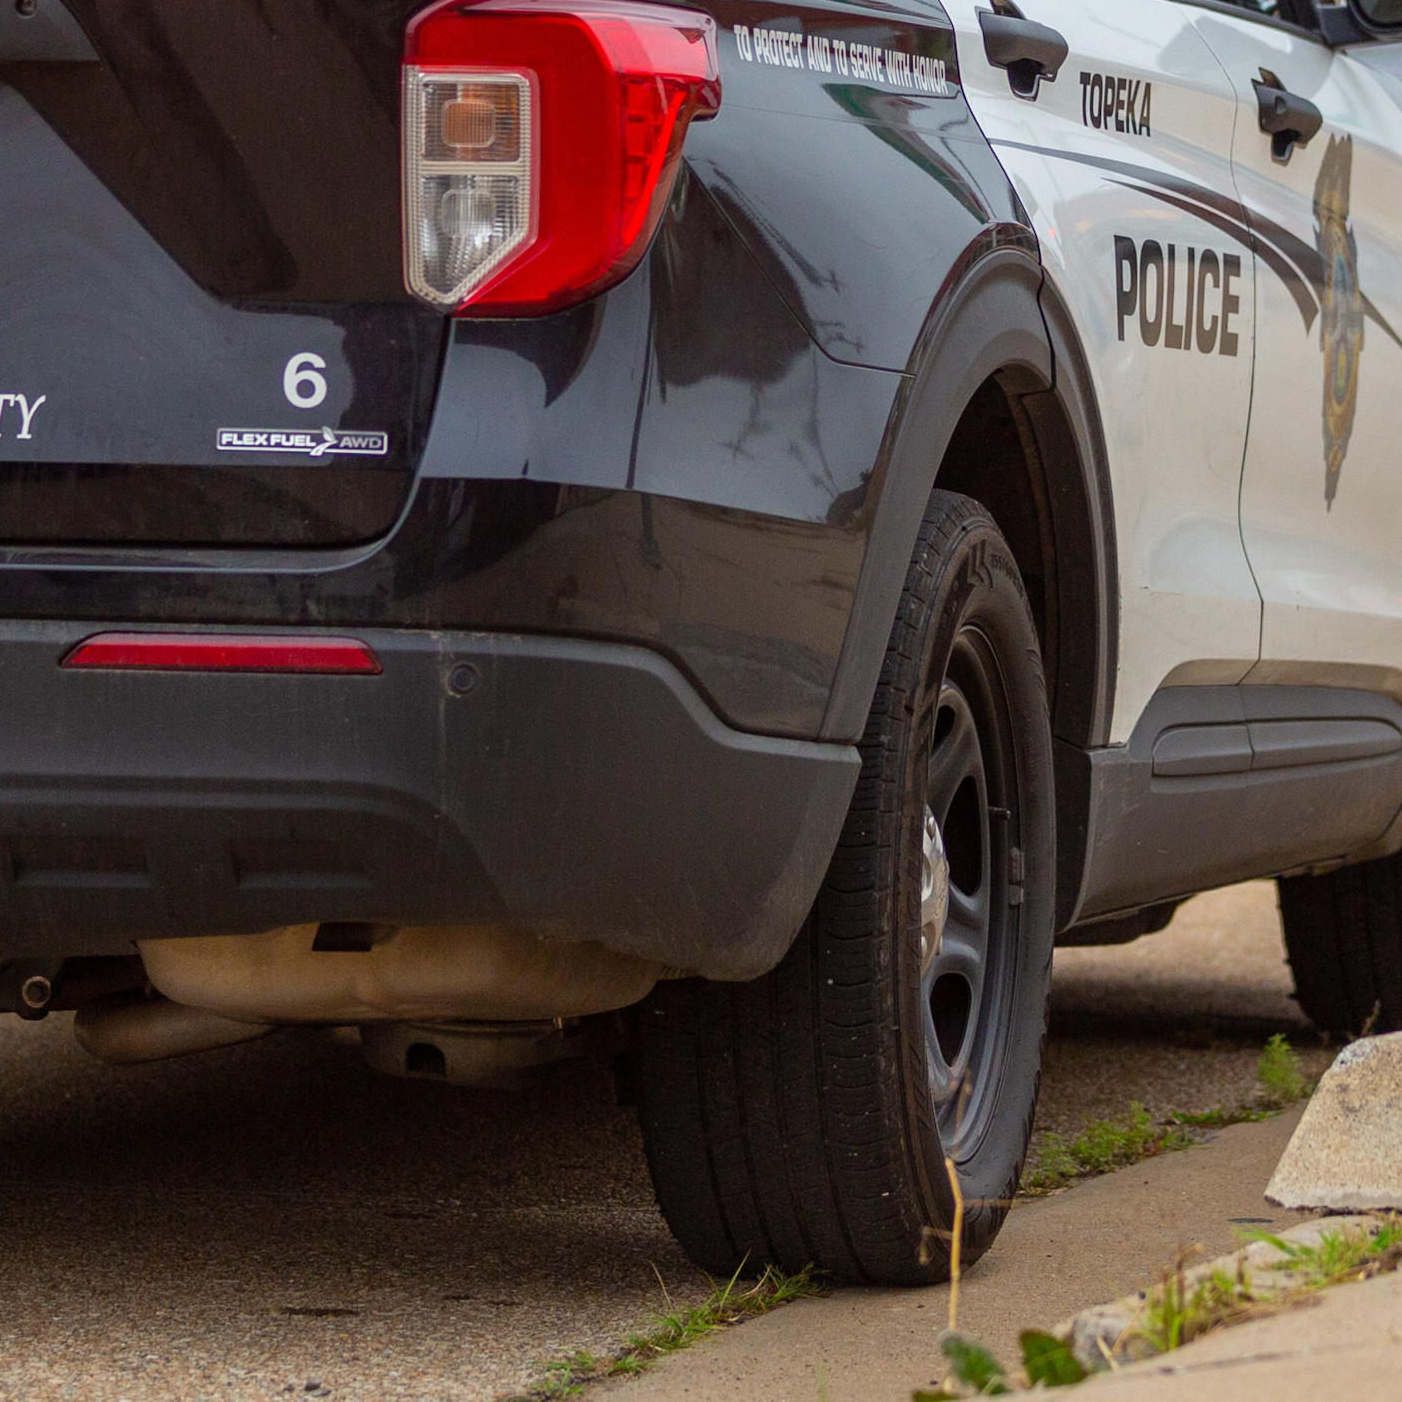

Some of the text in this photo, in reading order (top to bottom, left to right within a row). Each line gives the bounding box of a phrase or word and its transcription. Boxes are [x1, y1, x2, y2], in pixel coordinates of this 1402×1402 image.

[733, 25, 948, 94] TO PROTECT AND TO SERVE WITH HONOR
[1079, 72, 1151, 137] TOPEKA
[1114, 234, 1241, 357] POLICE
[283, 352, 327, 408] 6
[221, 433, 382, 448] FLEX FUEL AWD
